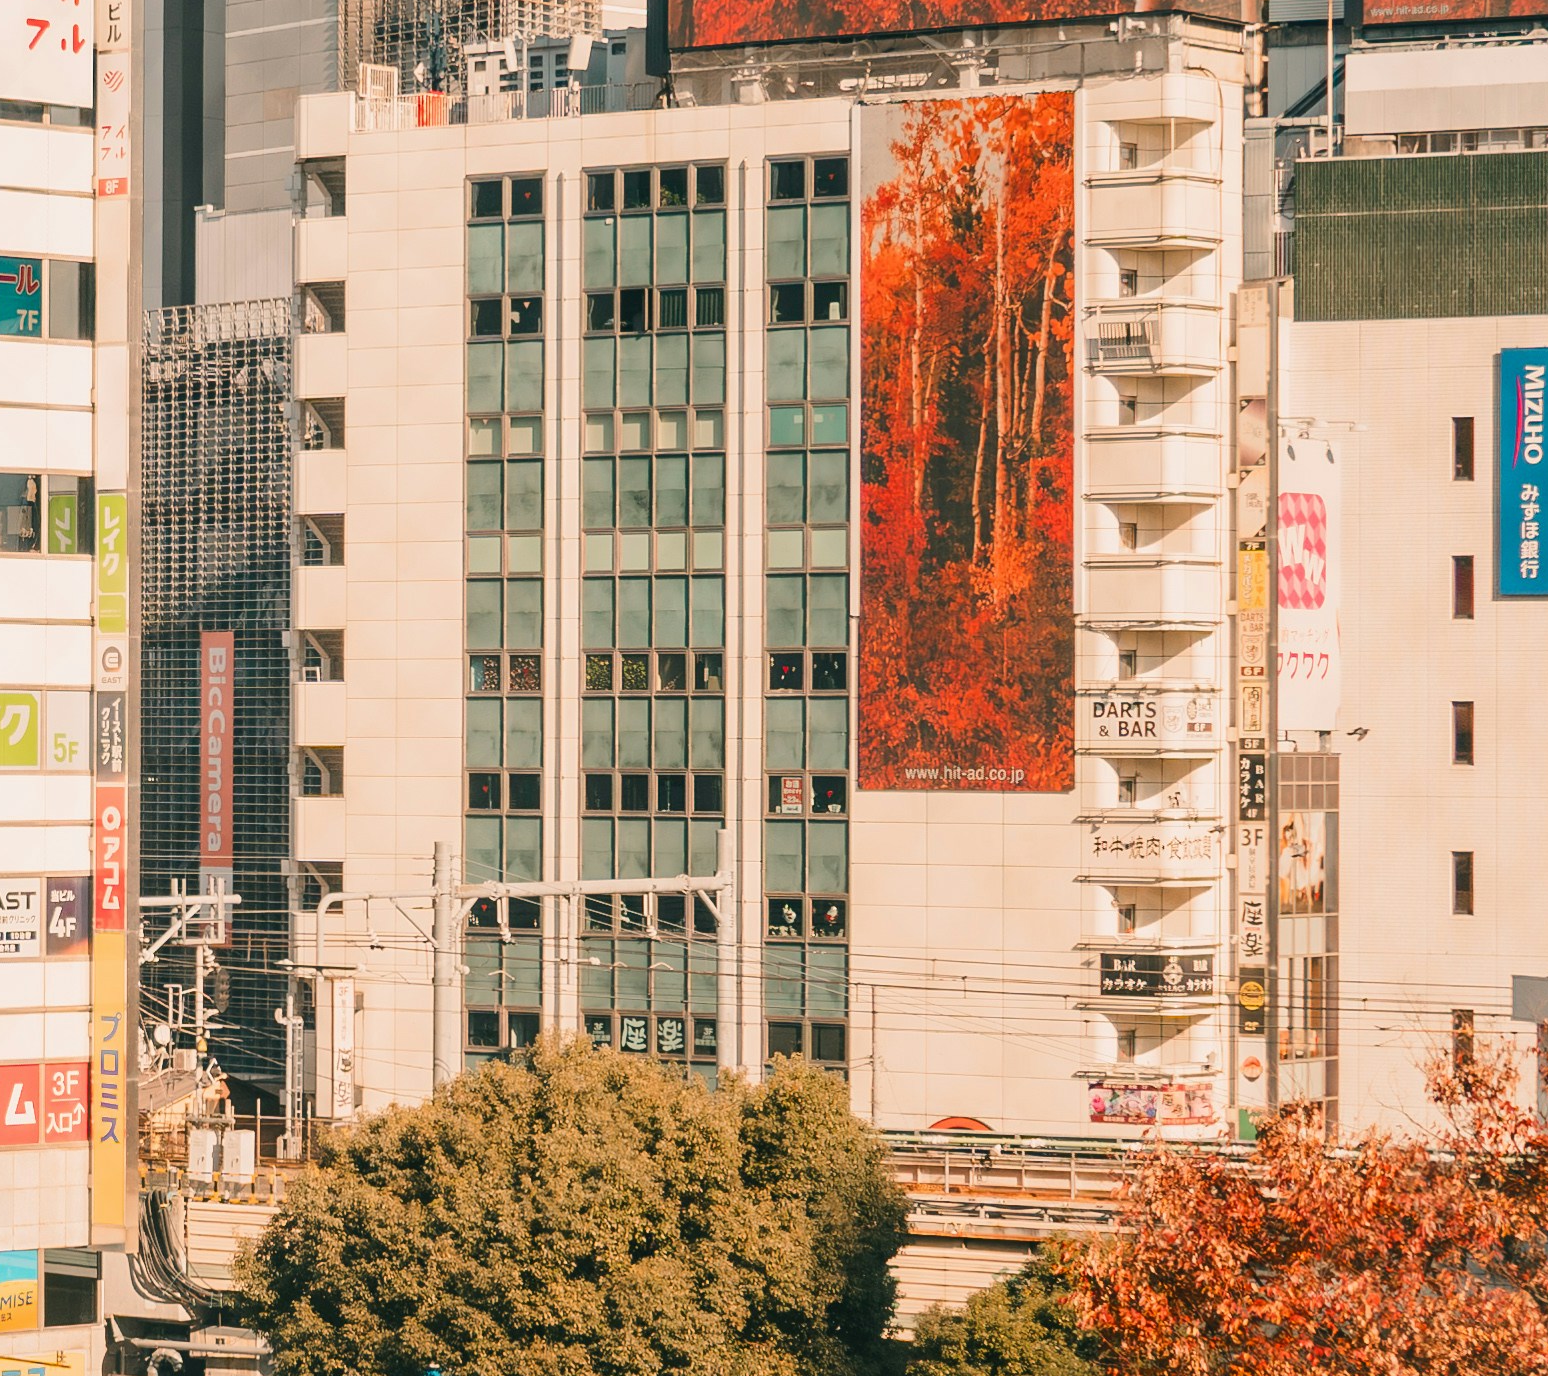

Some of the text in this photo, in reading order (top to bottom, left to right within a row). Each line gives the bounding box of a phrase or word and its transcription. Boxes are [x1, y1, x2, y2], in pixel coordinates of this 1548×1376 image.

[105, 180, 119, 194] 8F
[17, 310, 39, 331] 7F
[1520, 364, 1546, 466] MIZUHO
[102, 506, 120, 576] レイク
[1520, 484, 1540, 581] みずほ銀行
[1093, 702, 1156, 718] DARTS
[1099, 721, 1156, 737] & BAR
[53, 733, 80, 764] 5F
[206, 646, 227, 854] BicCamera
[904, 764, 1025, 784] www.hit-ad.co.jp
[1242, 828, 1263, 846] 3F
[102, 835, 120, 911] アコム
[50, 889, 75, 903] 当ビル
[49, 906, 76, 938] 4F
[1103, 977, 1147, 992] カラオケ
[52, 1070, 79, 1096] 3F
[100, 1012, 120, 1144] プロミス
